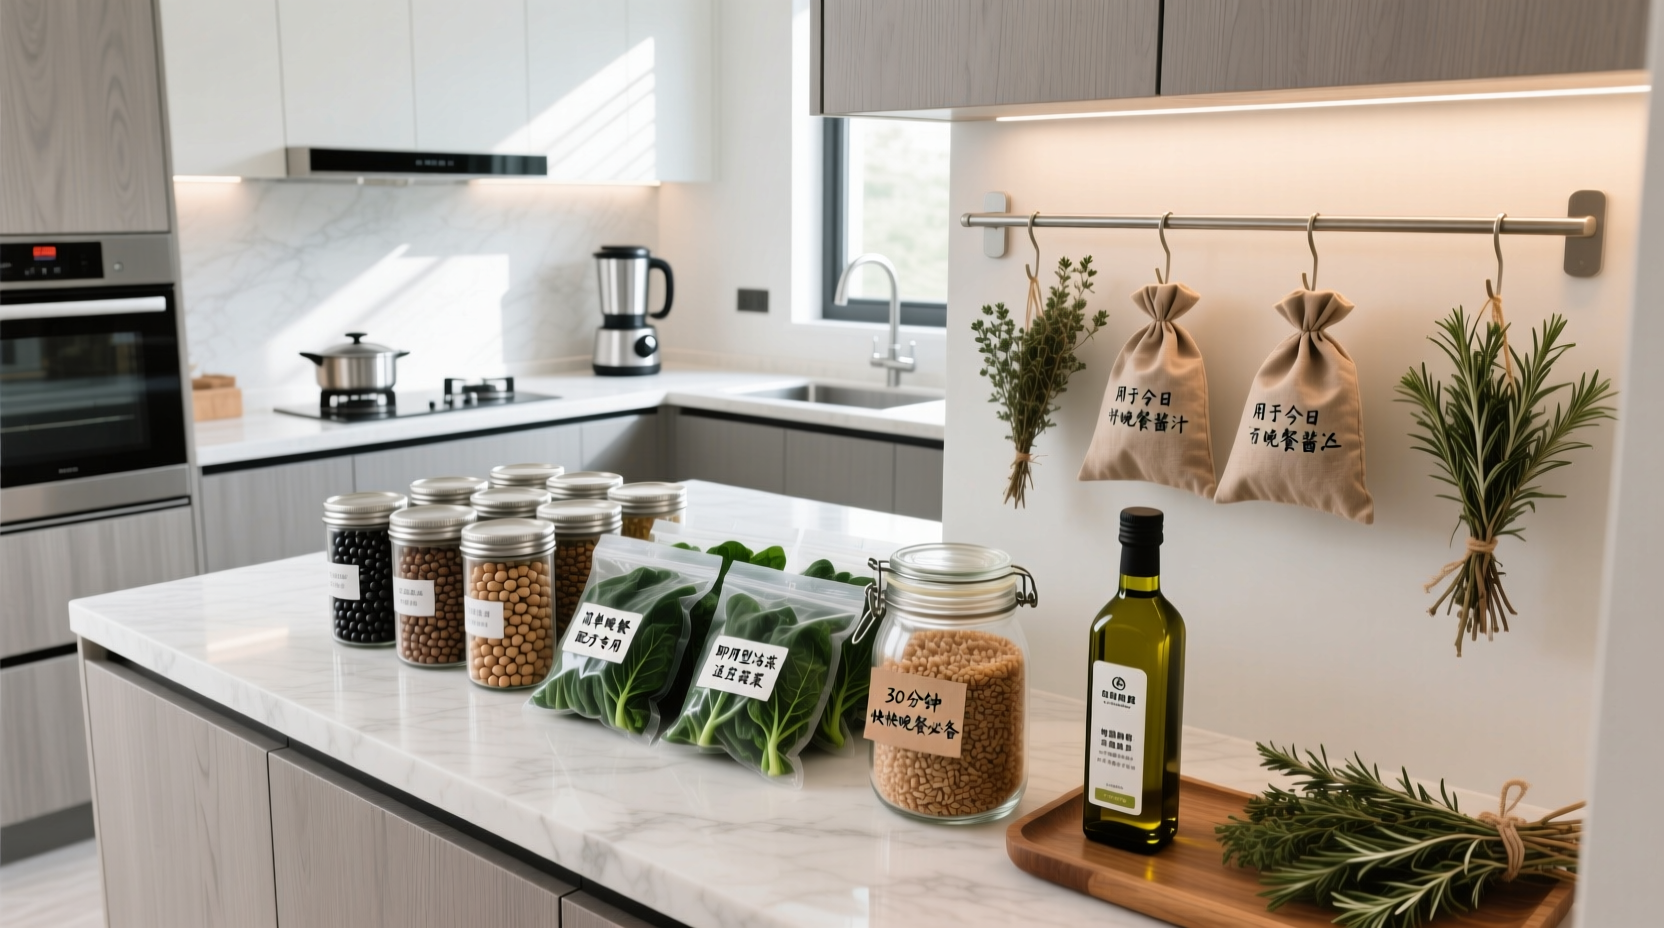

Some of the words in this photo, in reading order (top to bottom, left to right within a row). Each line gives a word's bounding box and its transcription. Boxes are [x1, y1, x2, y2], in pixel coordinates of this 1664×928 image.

[1115, 386, 1172, 407] 用于今日
[1253, 403, 1319, 426] 用于今日
[885, 687, 942, 713] 30分钟
